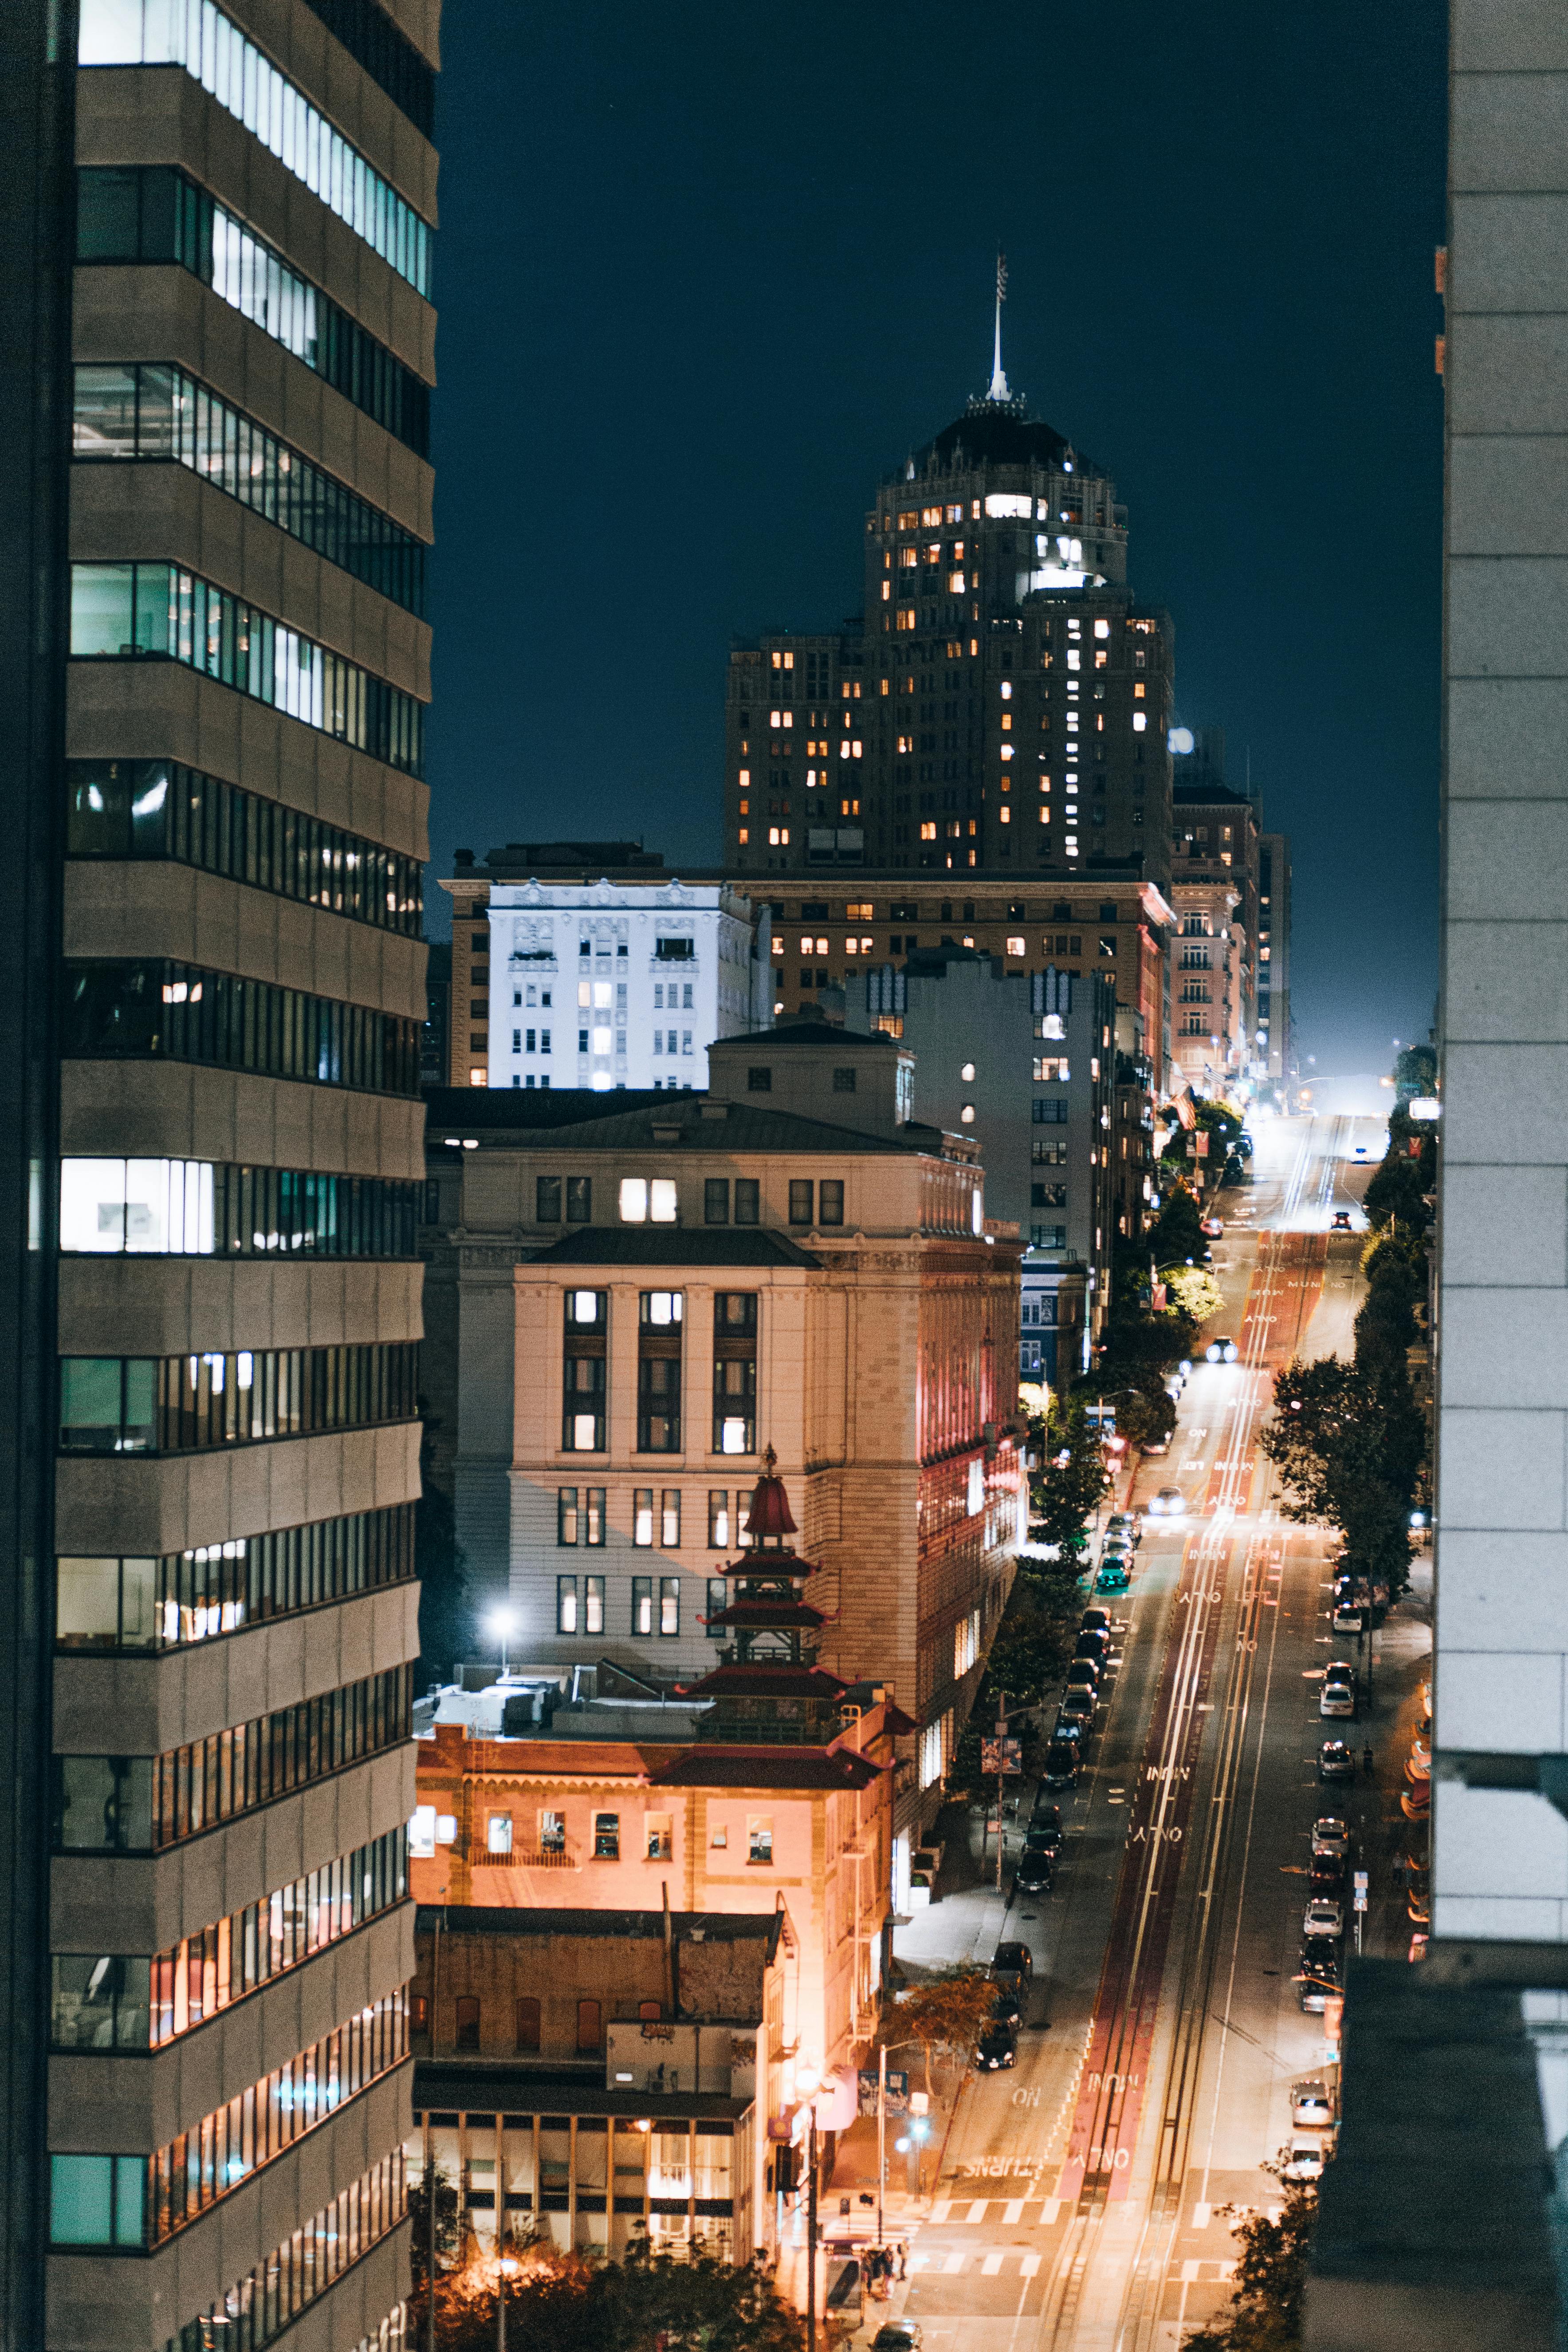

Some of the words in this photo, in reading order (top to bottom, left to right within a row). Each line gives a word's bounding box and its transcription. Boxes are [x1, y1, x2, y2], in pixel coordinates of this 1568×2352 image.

[1227, 1398, 1263, 1407] ONLY
[1188, 1429, 1207, 1437] NO
[1214, 1462, 1254, 1471] MUNI
[1208, 1496, 1246, 1506] ONLY
[1189, 1550, 1226, 1560] MUNI
[1179, 1592, 1221, 1603] ONLY
[1236, 1641, 1258, 1652] NO
[1146, 1767, 1190, 1780] MUNI
[1133, 1827, 1182, 1842] ONLY
[1088, 2073, 1139, 2093] MUNI
[1012, 2086, 1042, 2108] NO
[1072, 2147, 1129, 2170] ONLY
[963, 2156, 1033, 2177] TURNS
